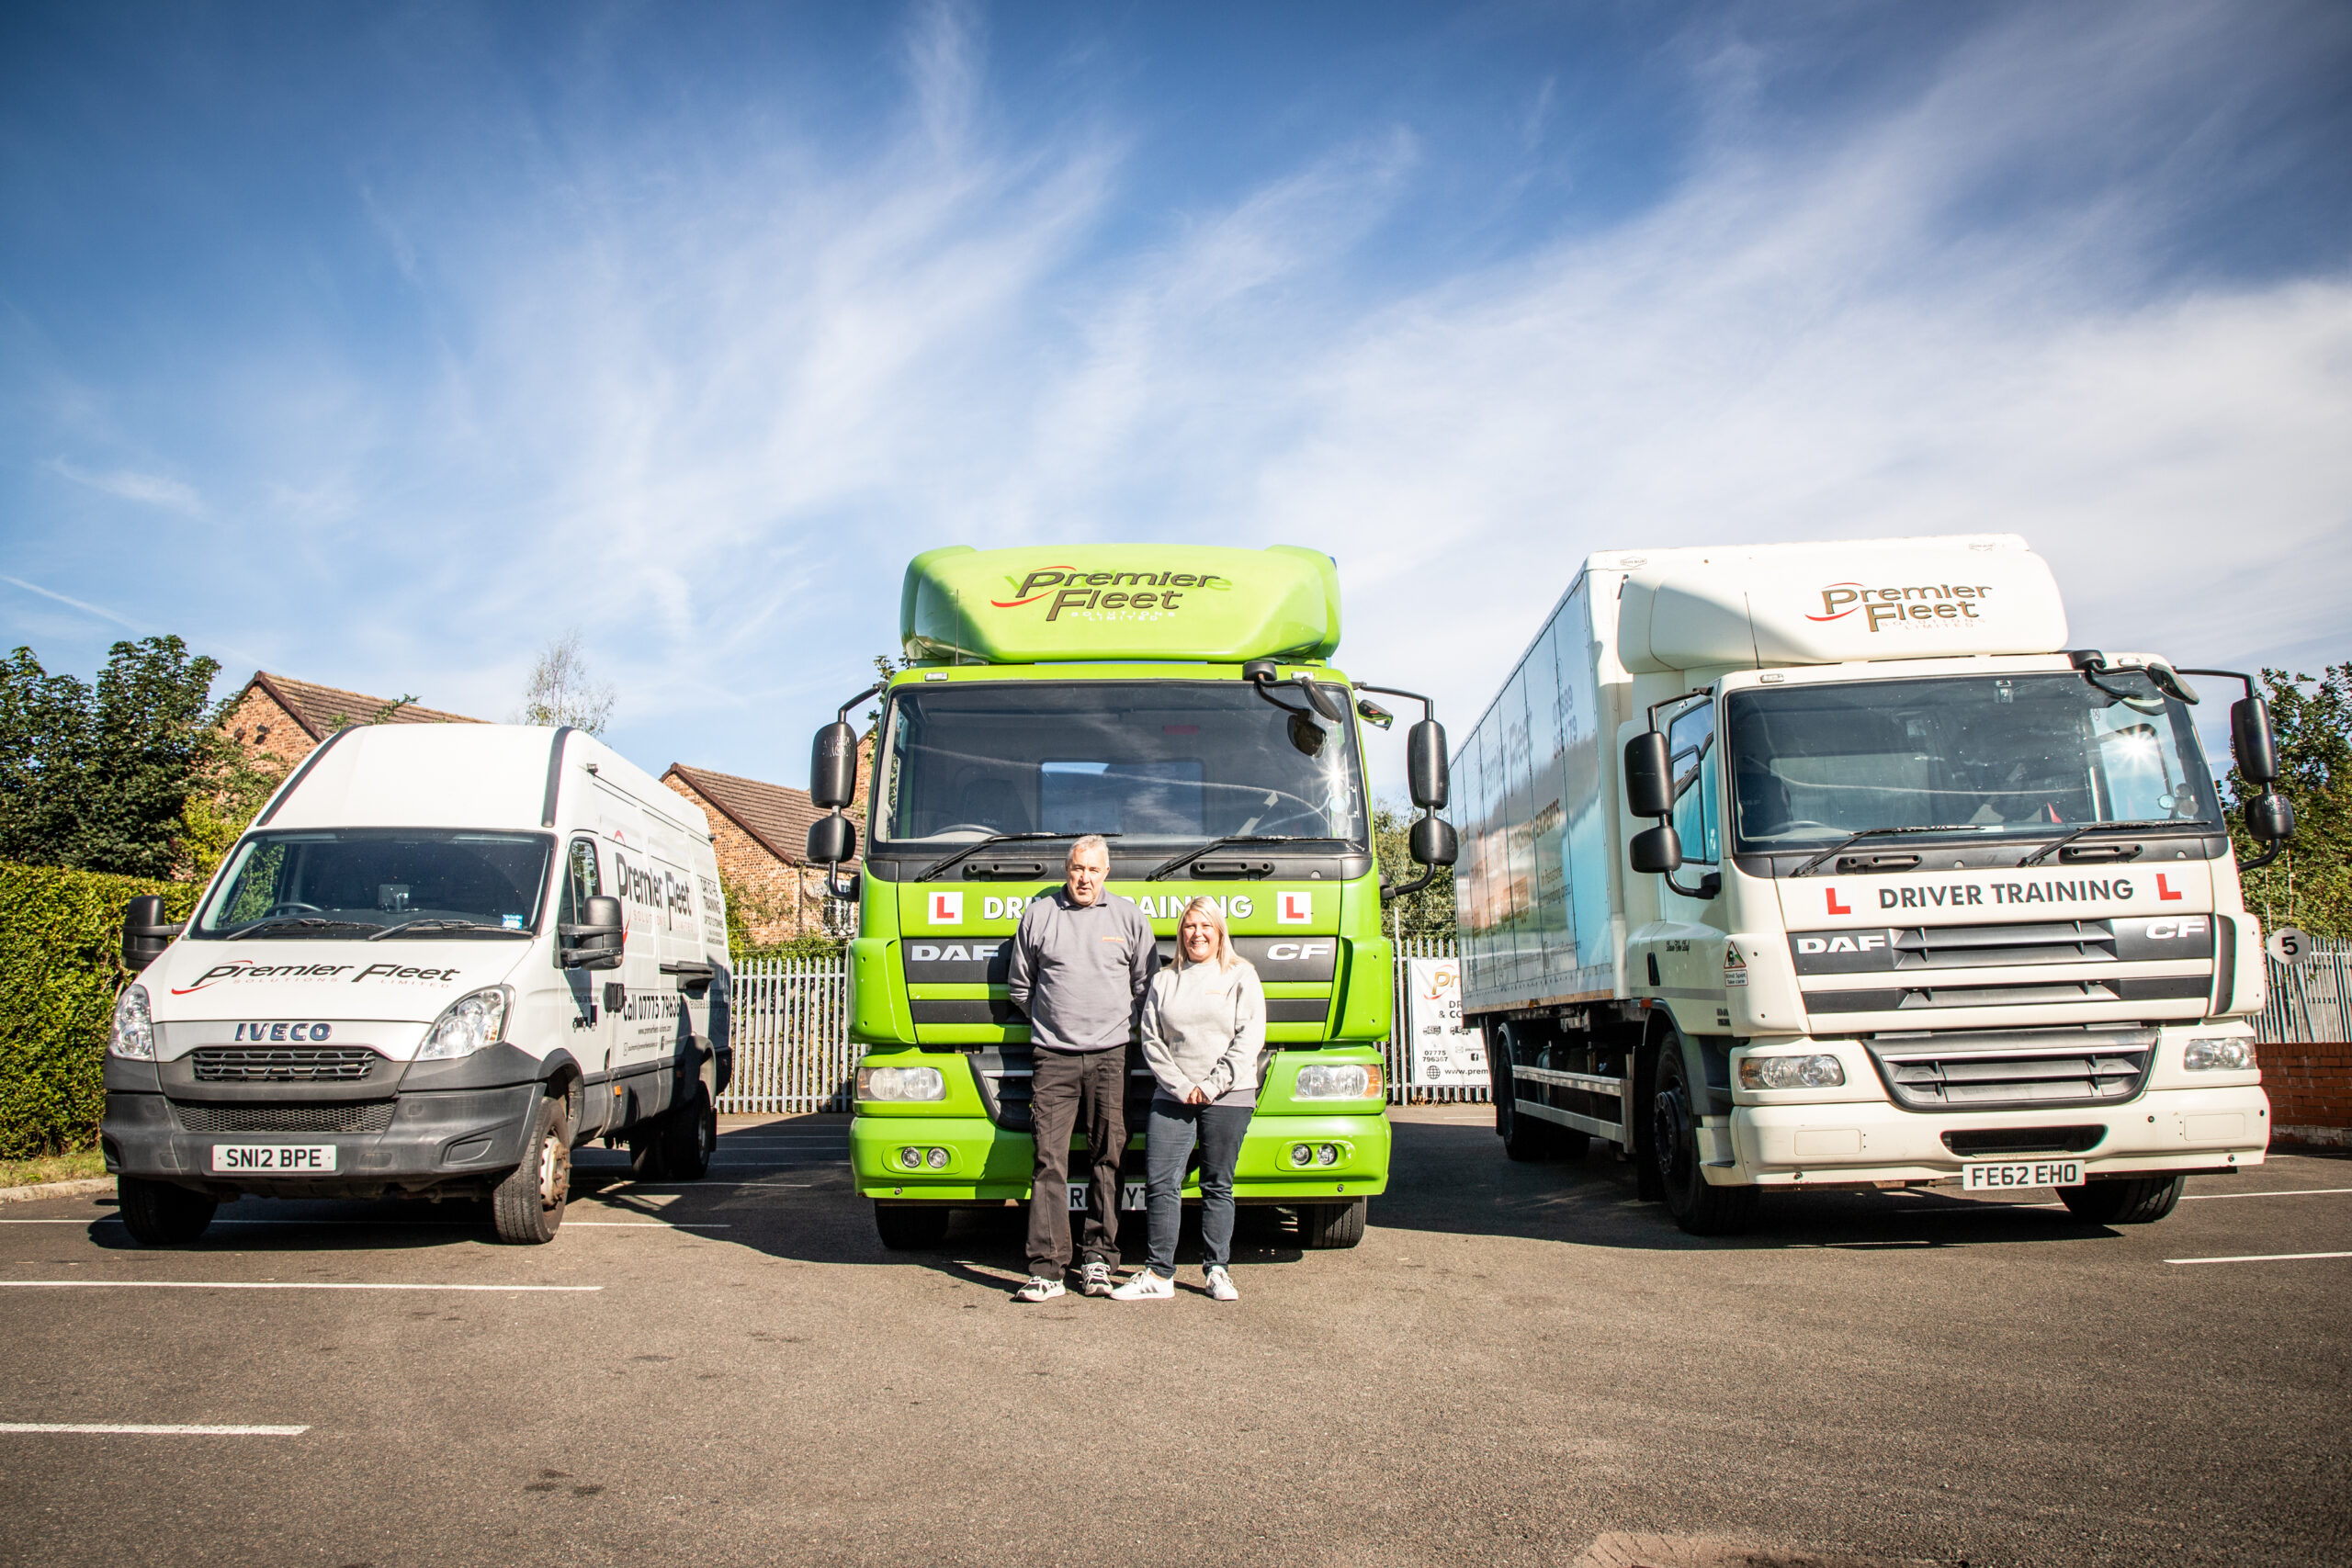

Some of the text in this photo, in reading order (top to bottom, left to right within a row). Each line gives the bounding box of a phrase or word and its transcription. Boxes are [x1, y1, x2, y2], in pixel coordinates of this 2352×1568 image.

[1015, 571, 1220, 598] Premier
[1046, 589, 1183, 622] Fleet
[1821, 584, 1993, 615] Premier
[1864, 601, 1980, 632] Fleet
[615, 852, 692, 931] Premier Fleet
[1826, 873, 2182, 915] L DRIVER TRAINING L
[936, 896, 955, 919] L
[1285, 897, 1304, 919] L
[1796, 920, 2206, 954] DAF CF
[2281, 936, 2299, 955] 5
[910, 943, 1329, 962] DAF CF
[190, 964, 461, 987] Premier Fleet
[380, 979, 449, 988] LIMITED
[624, 995, 637, 1021] Call
[639, 996, 660, 1020] 07775
[234, 1022, 332, 1042] IVECO
[226, 1149, 322, 1168] SN12 BPE
[1972, 1166, 2029, 1187] FE62
